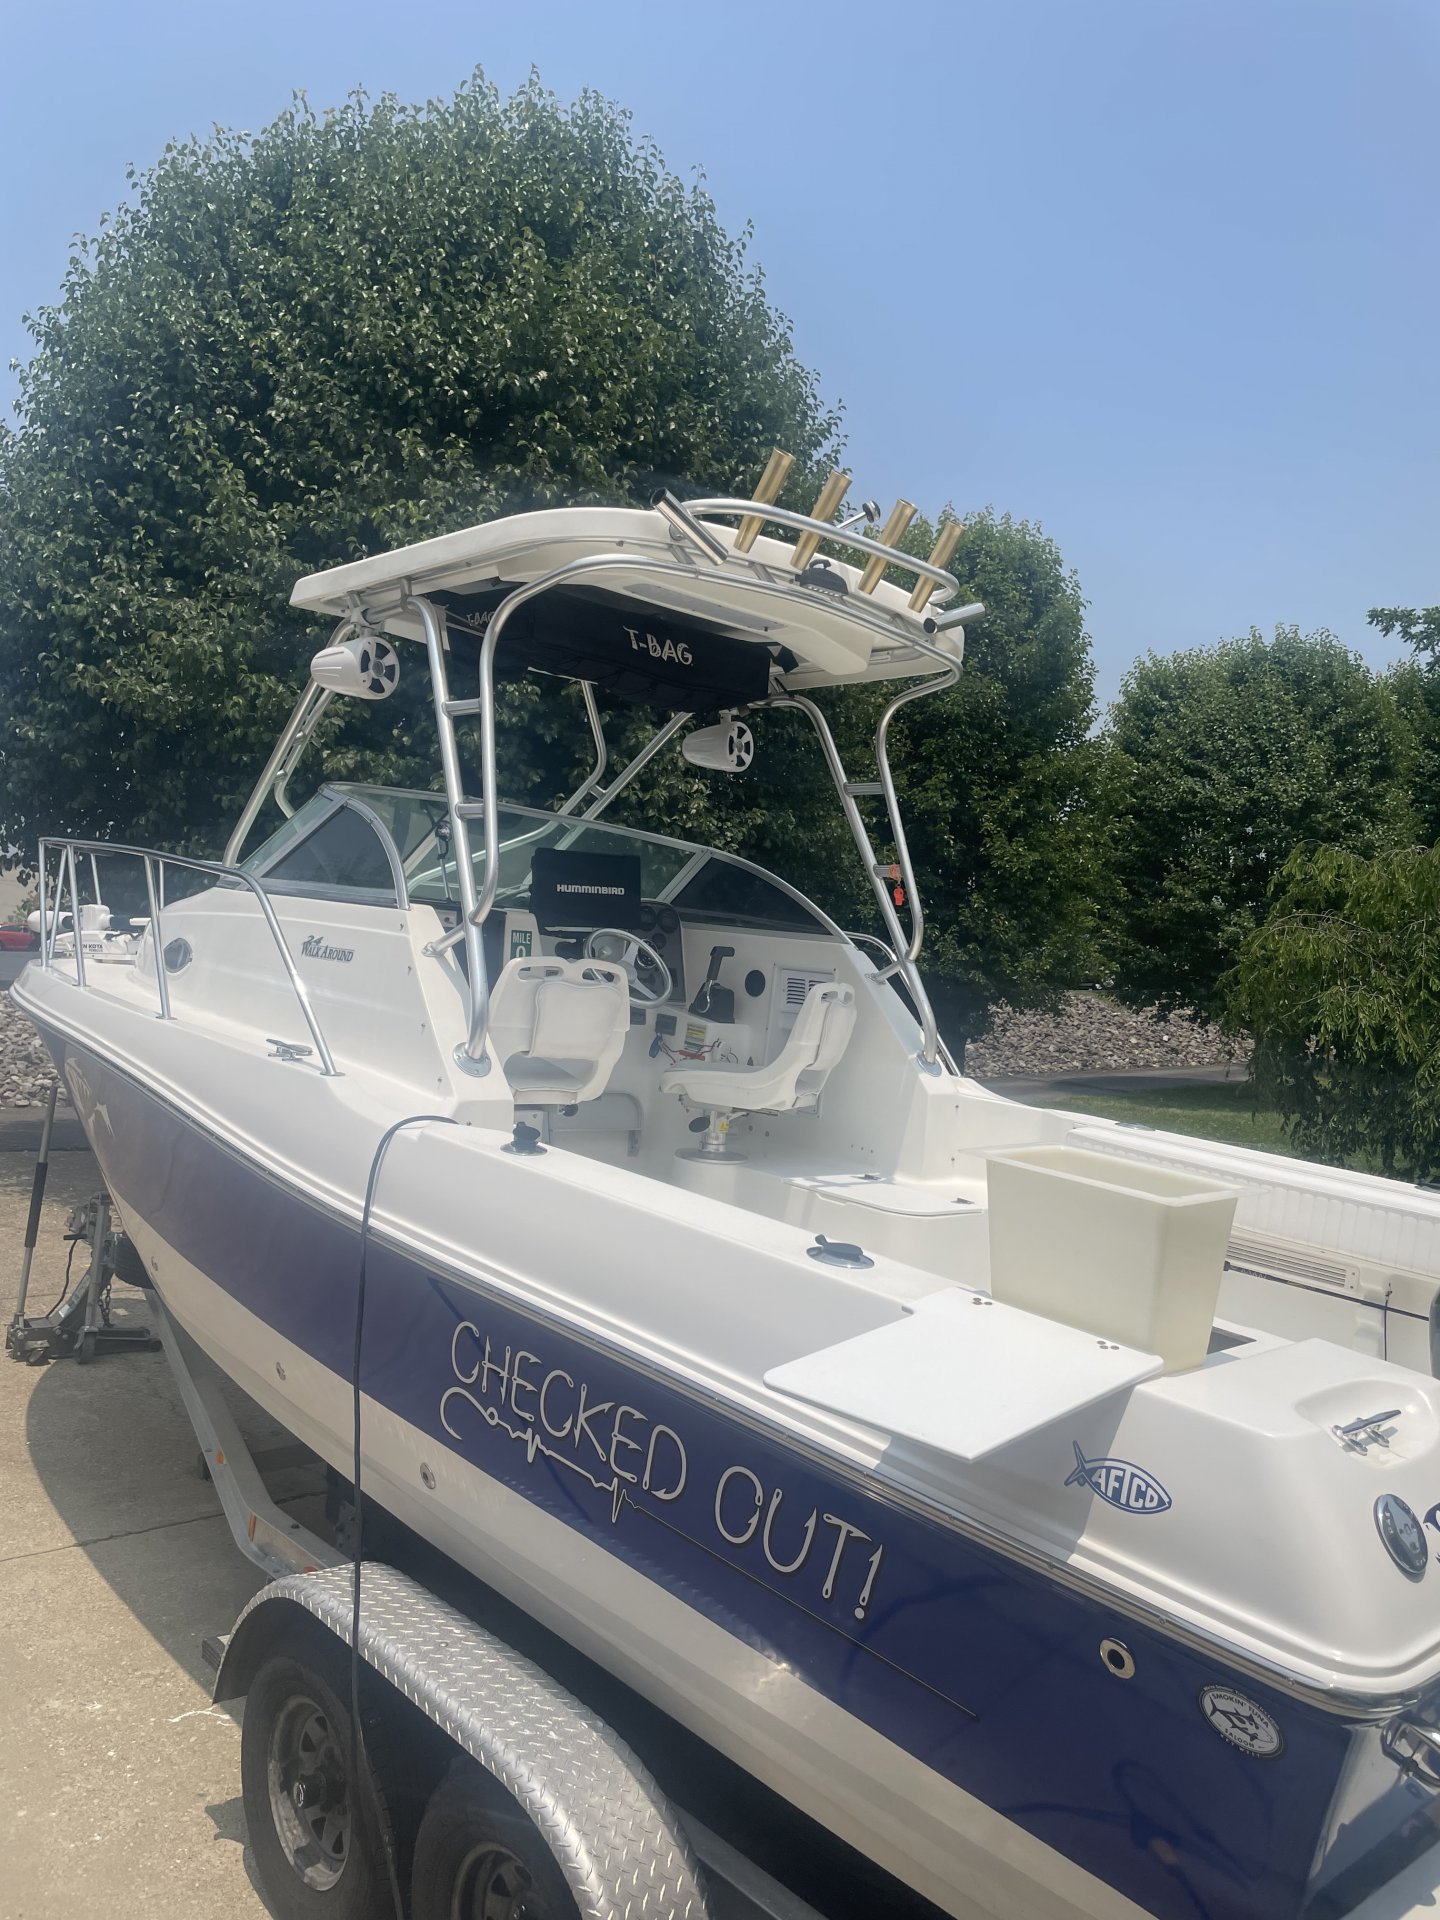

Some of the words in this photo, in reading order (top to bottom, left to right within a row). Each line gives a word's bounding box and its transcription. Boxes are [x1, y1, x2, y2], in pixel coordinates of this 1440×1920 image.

[622, 625, 693, 666] T-BAG
[556, 884, 625, 895] HUMMINBIRD
[512, 931, 531, 944] MILE
[451, 1320, 688, 1501] CHECKED
[715, 1465, 883, 1620] OUT!
[1091, 1466, 1159, 1508] AFTCO
[1248, 1705, 1270, 1729] TUNA
[1225, 1727, 1256, 1749] SALOON
